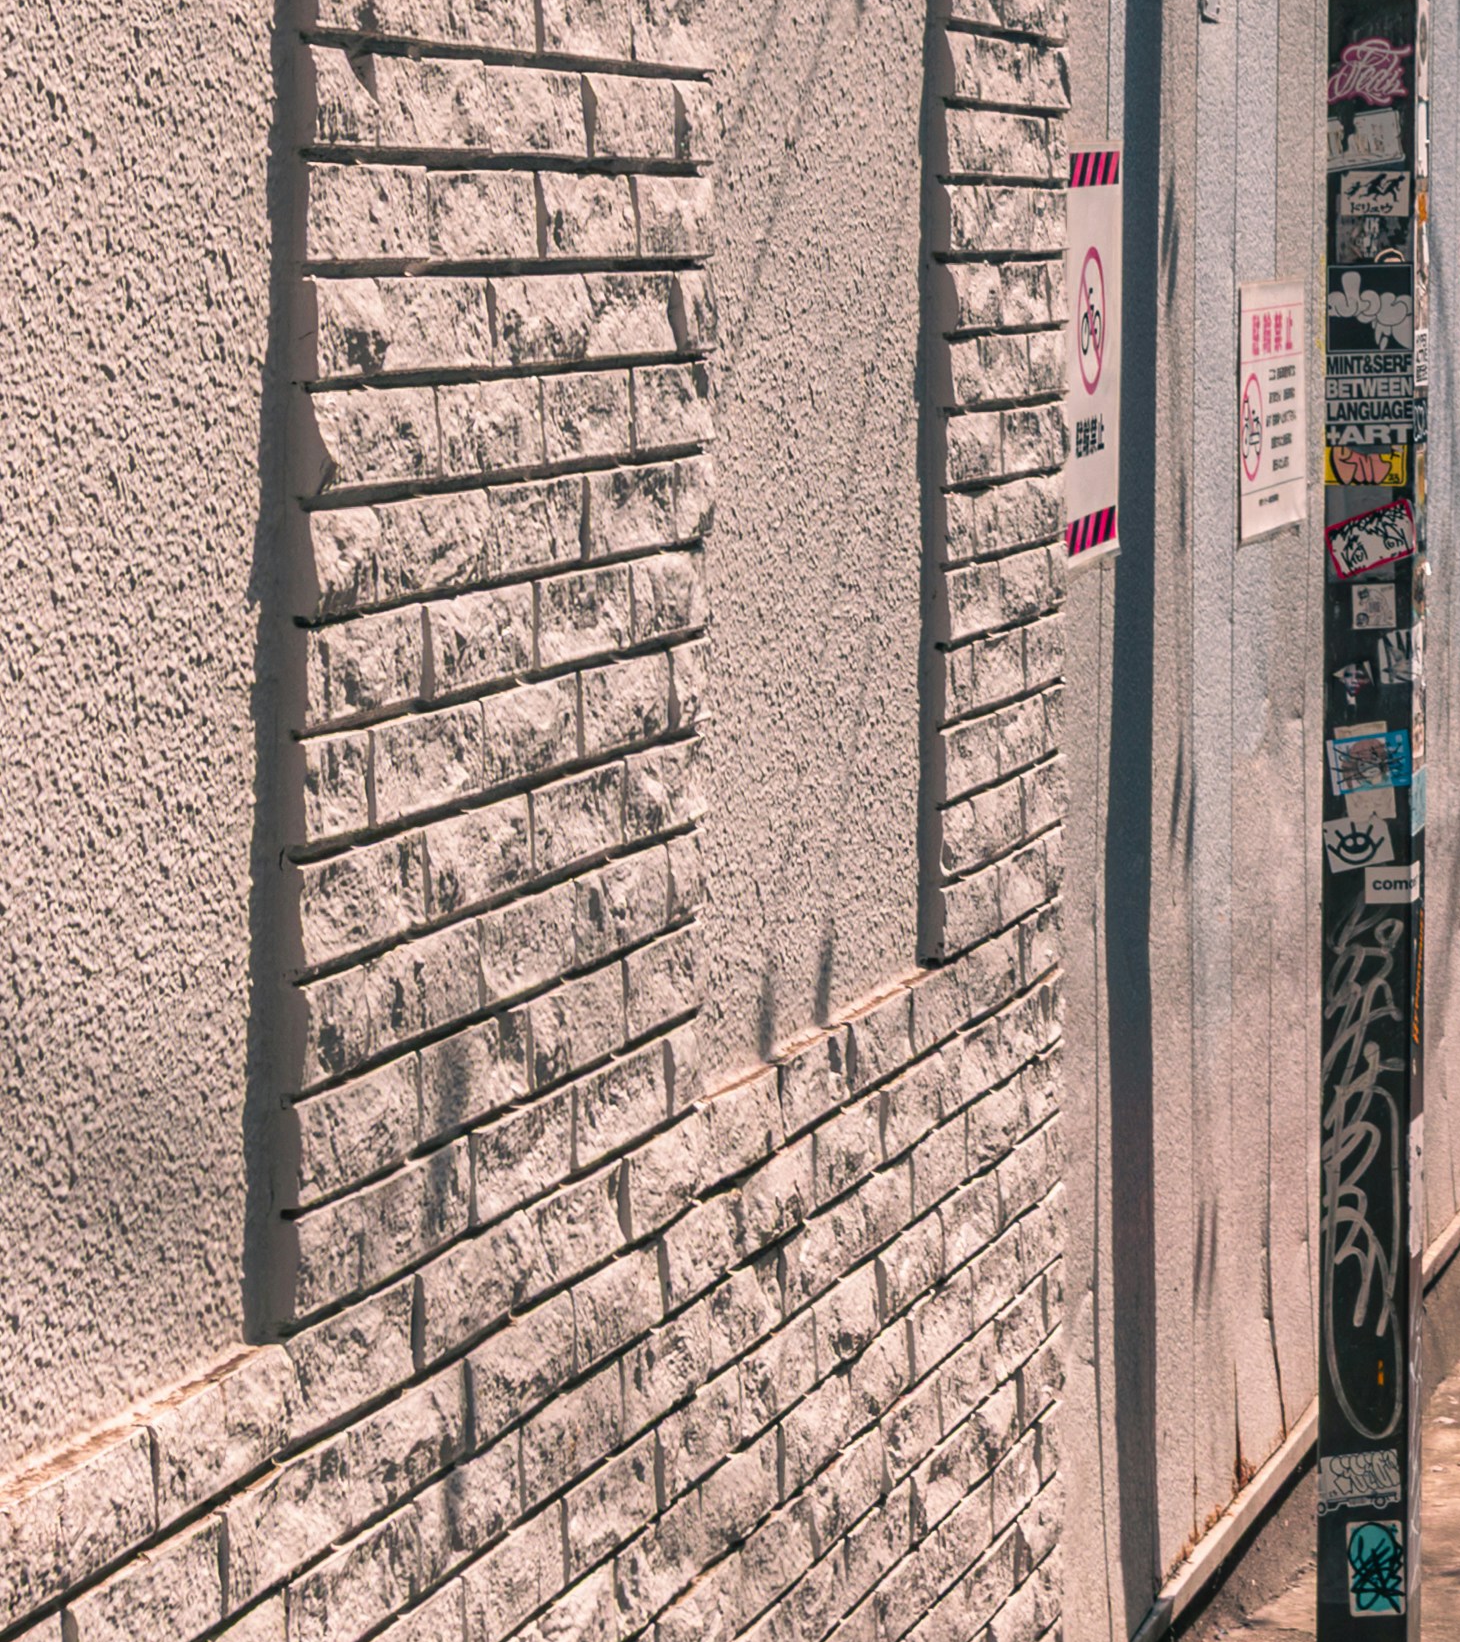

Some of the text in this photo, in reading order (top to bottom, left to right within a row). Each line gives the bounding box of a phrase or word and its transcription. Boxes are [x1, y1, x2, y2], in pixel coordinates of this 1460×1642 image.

[1326, 354, 1412, 376] MINT&SERF
[1326, 377, 1412, 399] BETWEEN
[1326, 400, 1413, 422] LANGUAGE
